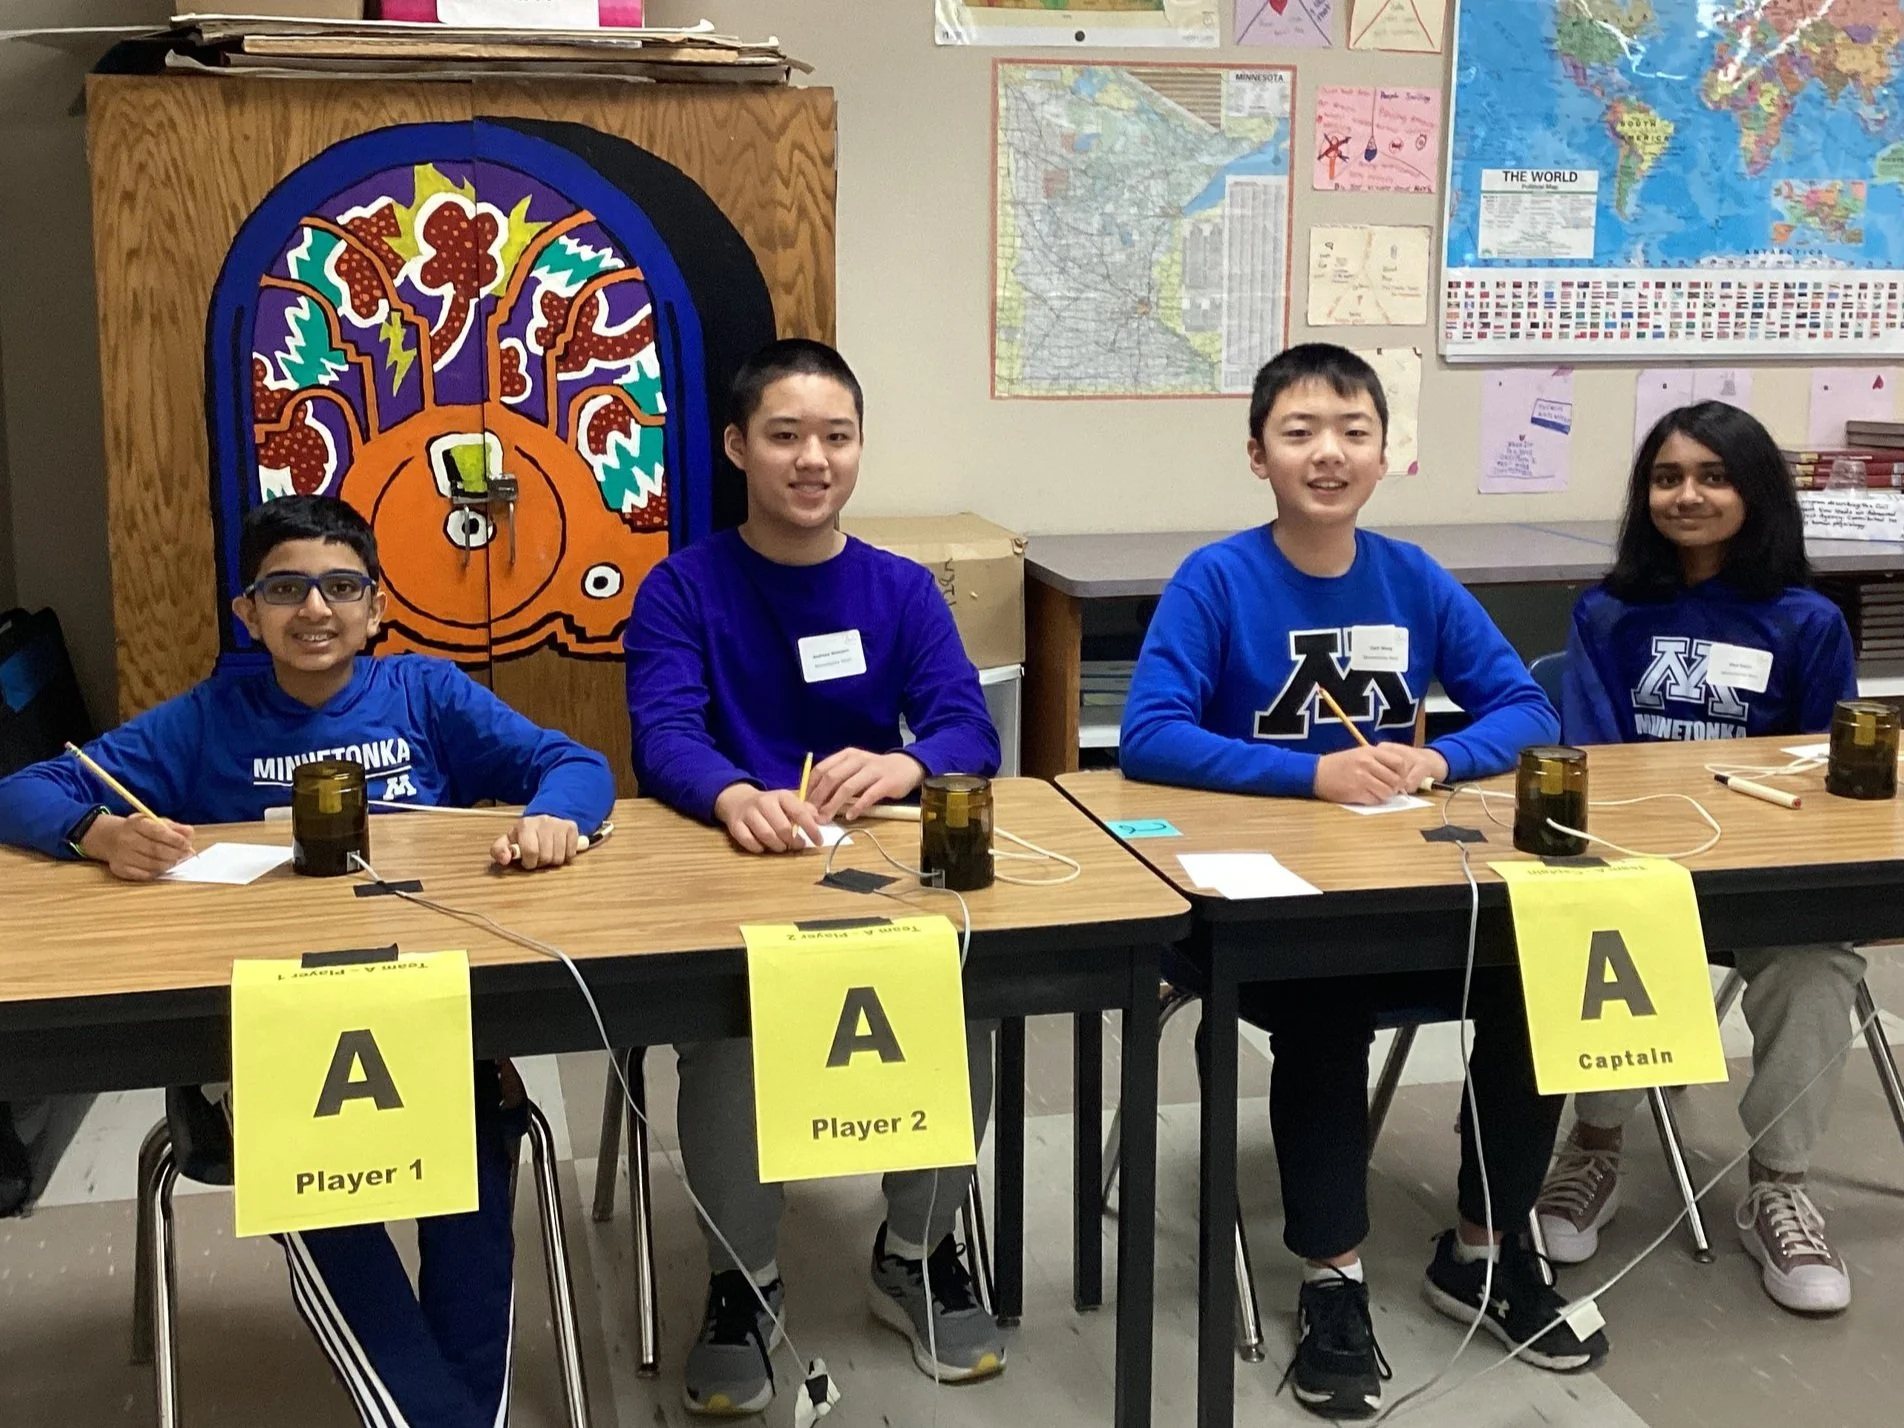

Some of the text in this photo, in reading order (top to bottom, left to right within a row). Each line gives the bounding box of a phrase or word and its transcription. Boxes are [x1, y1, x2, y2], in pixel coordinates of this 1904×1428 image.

[1235, 73, 1284, 82] MINNESOTA
[1502, 170, 1578, 183] THE WORLD
[382, 774, 417, 801] M
[801, 932, 849, 941] Player
[880, 925, 922, 933] Team
[291, 968, 346, 978] Player
[381, 962, 429, 971] Team
[1581, 930, 1658, 1021] A
[825, 986, 907, 1069] A
[1578, 1047, 1674, 1072] Captain
[313, 1028, 405, 1119] A
[811, 1109, 928, 1141] Player 2
[296, 1158, 423, 1195] Player 1
